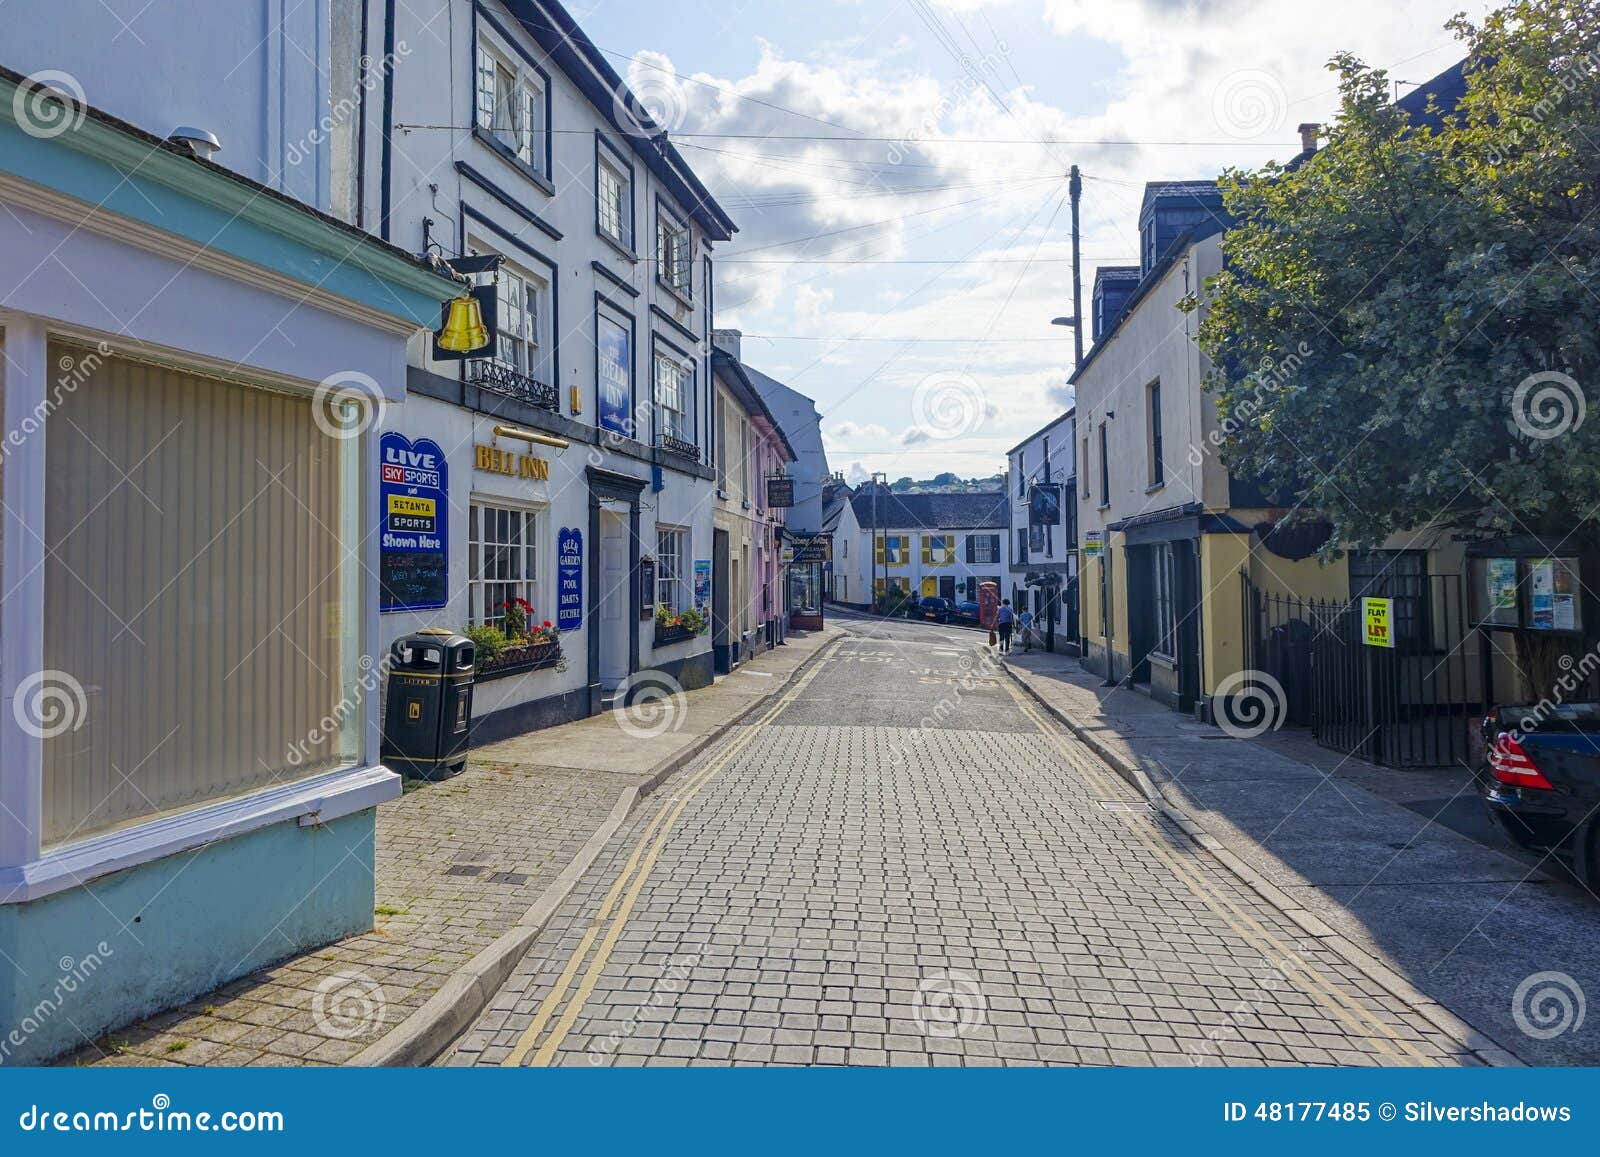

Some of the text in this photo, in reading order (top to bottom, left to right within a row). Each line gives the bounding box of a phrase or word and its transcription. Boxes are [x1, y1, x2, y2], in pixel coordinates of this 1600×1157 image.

[606, 383, 624, 409] INN
[386, 447, 436, 469] LIVE
[476, 444, 549, 481] BELL INN
[384, 467, 438, 486] SKY SPORTS
[393, 500, 431, 512] SETANTA
[394, 517, 431, 529] SPORTS
[382, 533, 440, 549] Shown Here
[560, 555, 581, 566] GARDEN
[563, 579, 577, 590] POOL
[561, 594, 579, 605] DARTS
[1368, 609, 1385, 617] FLAT
[1368, 624, 1386, 636] LET
